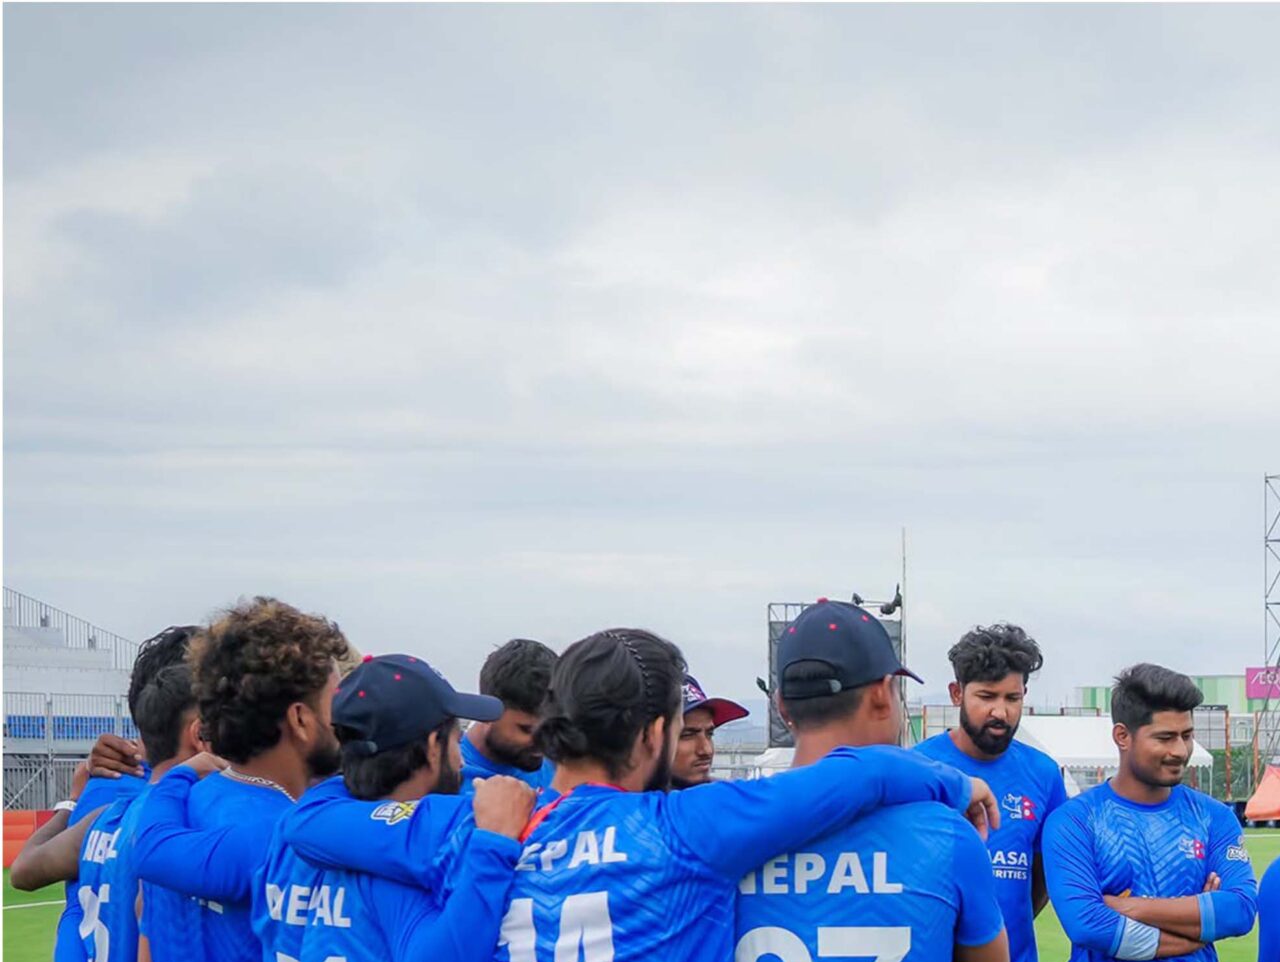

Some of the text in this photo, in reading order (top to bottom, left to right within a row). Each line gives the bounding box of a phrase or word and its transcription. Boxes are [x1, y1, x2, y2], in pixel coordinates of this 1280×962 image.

[514, 826, 628, 871] EPAL
[987, 849, 1028, 866] ASA
[992, 869, 1028, 880] RITIES
